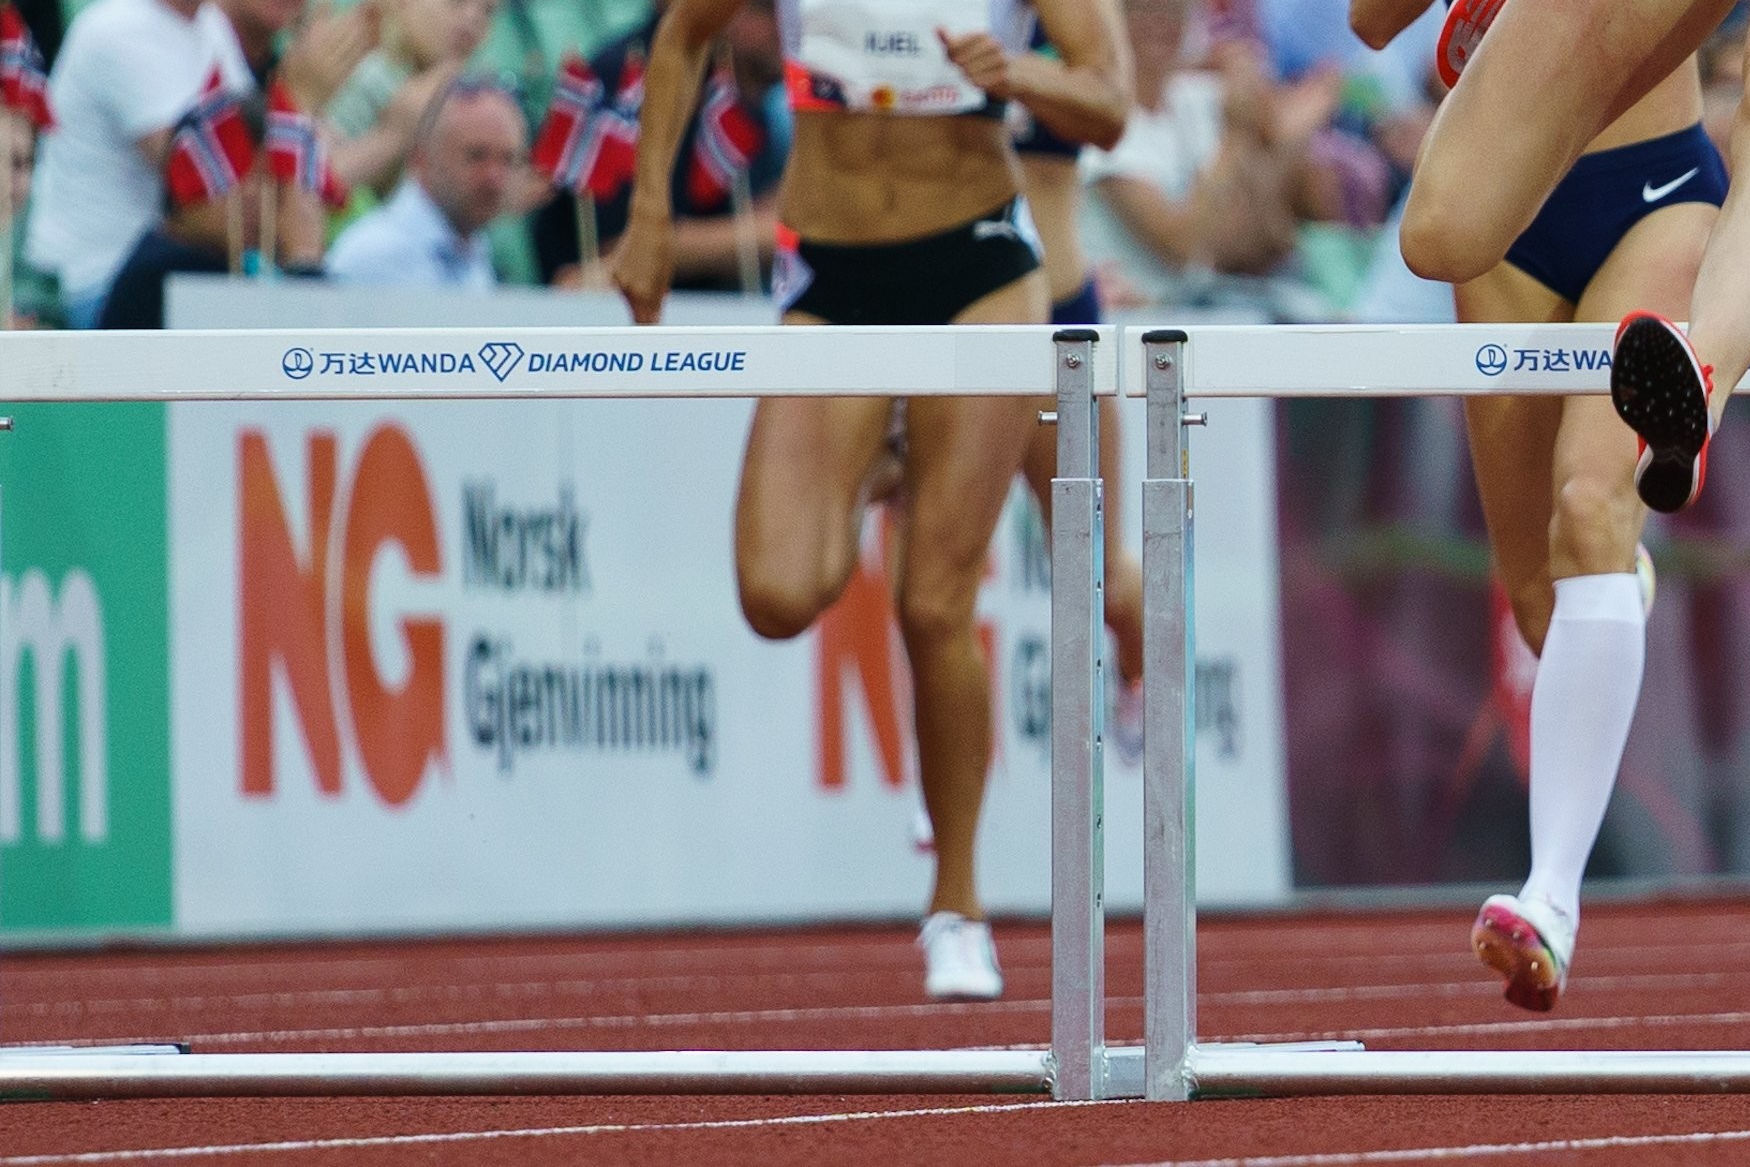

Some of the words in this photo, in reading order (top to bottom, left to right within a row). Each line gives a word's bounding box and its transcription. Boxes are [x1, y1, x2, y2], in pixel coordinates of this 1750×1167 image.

[528, 351, 645, 374] DIAMOND
[650, 350, 747, 373] LEAGUE
[462, 479, 590, 591] Norsk
[238, 421, 448, 807] NG
